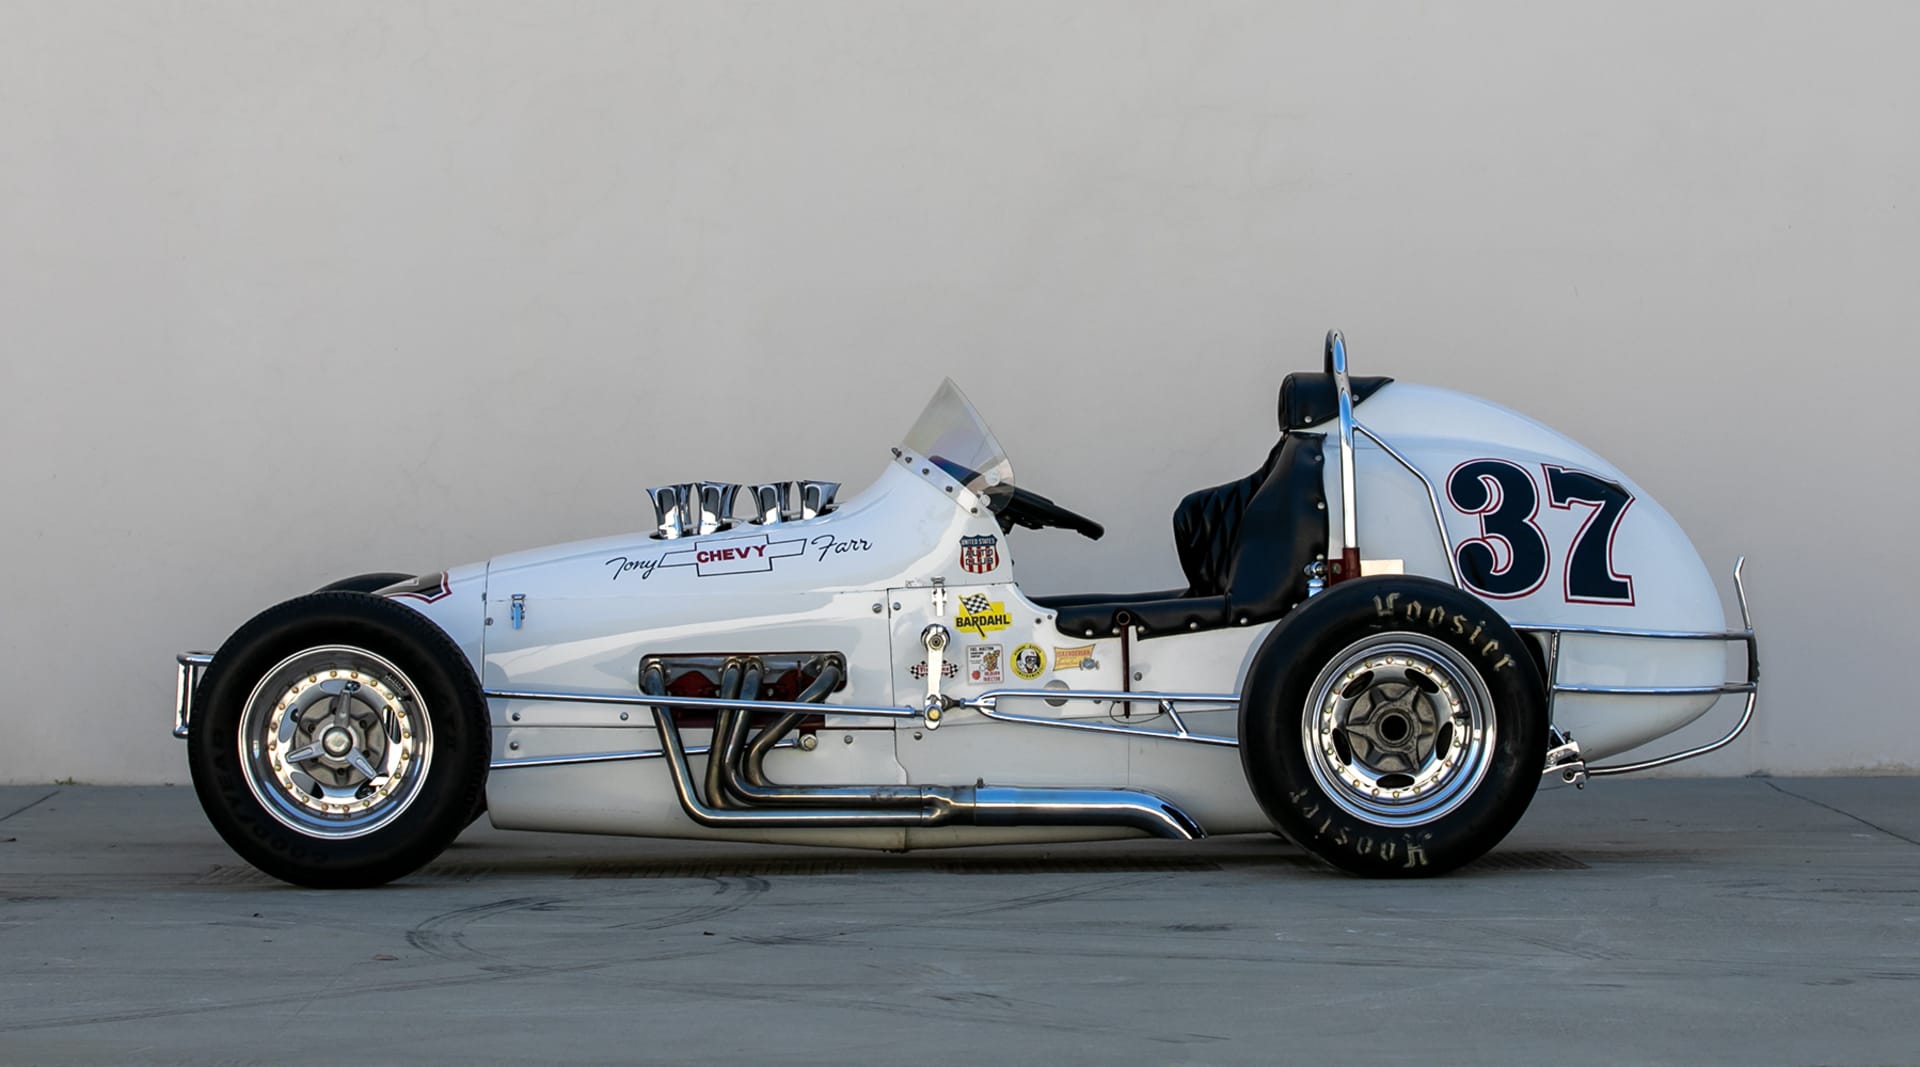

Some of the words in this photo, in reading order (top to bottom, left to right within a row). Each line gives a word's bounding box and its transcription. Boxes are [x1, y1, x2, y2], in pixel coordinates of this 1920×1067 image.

[1446, 458, 1635, 607] 37
[979, 537, 996, 545] STATES
[605, 556, 658, 580] Tony
[696, 544, 767, 563] CHEVY
[811, 534, 873, 562] Farr
[965, 548, 993, 558] AUTO
[965, 557, 994, 566] CLUB
[956, 614, 1011, 628] BARDAHL
